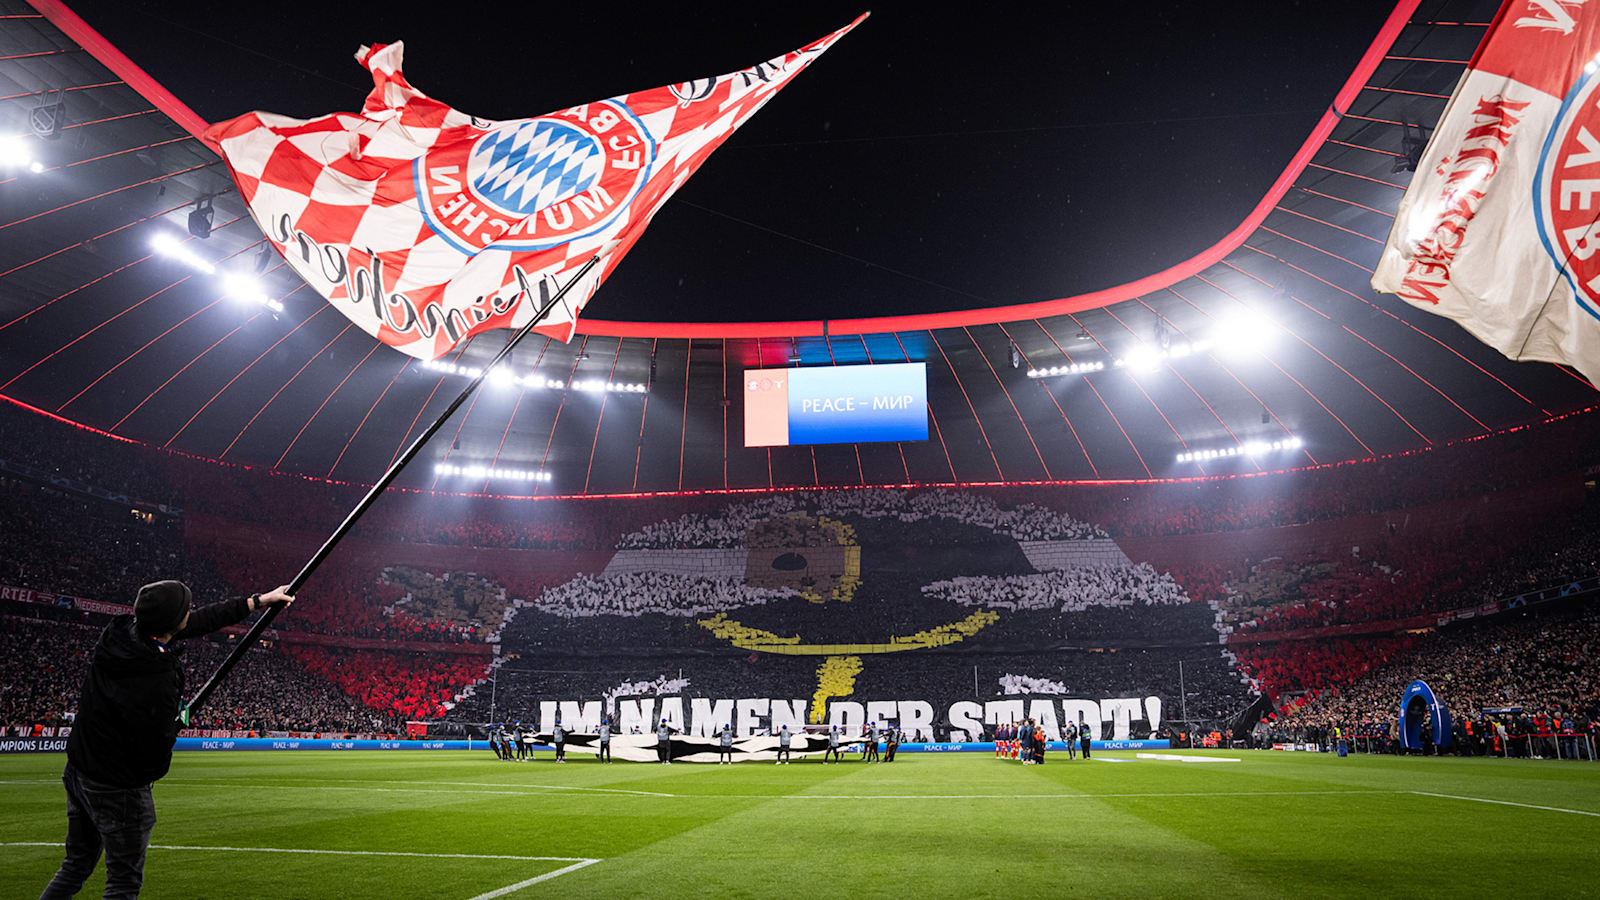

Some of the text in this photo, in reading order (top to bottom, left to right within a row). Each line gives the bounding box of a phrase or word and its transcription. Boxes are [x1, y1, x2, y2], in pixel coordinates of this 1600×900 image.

[802, 397, 856, 413] PEACE
[872, 395, 913, 411] МИР
[1, 587, 33, 603] RTEL
[540, 696, 1162, 743] IM NAMEN DER STADT!
[0, 740, 67, 751] MPIONS LEAGU
